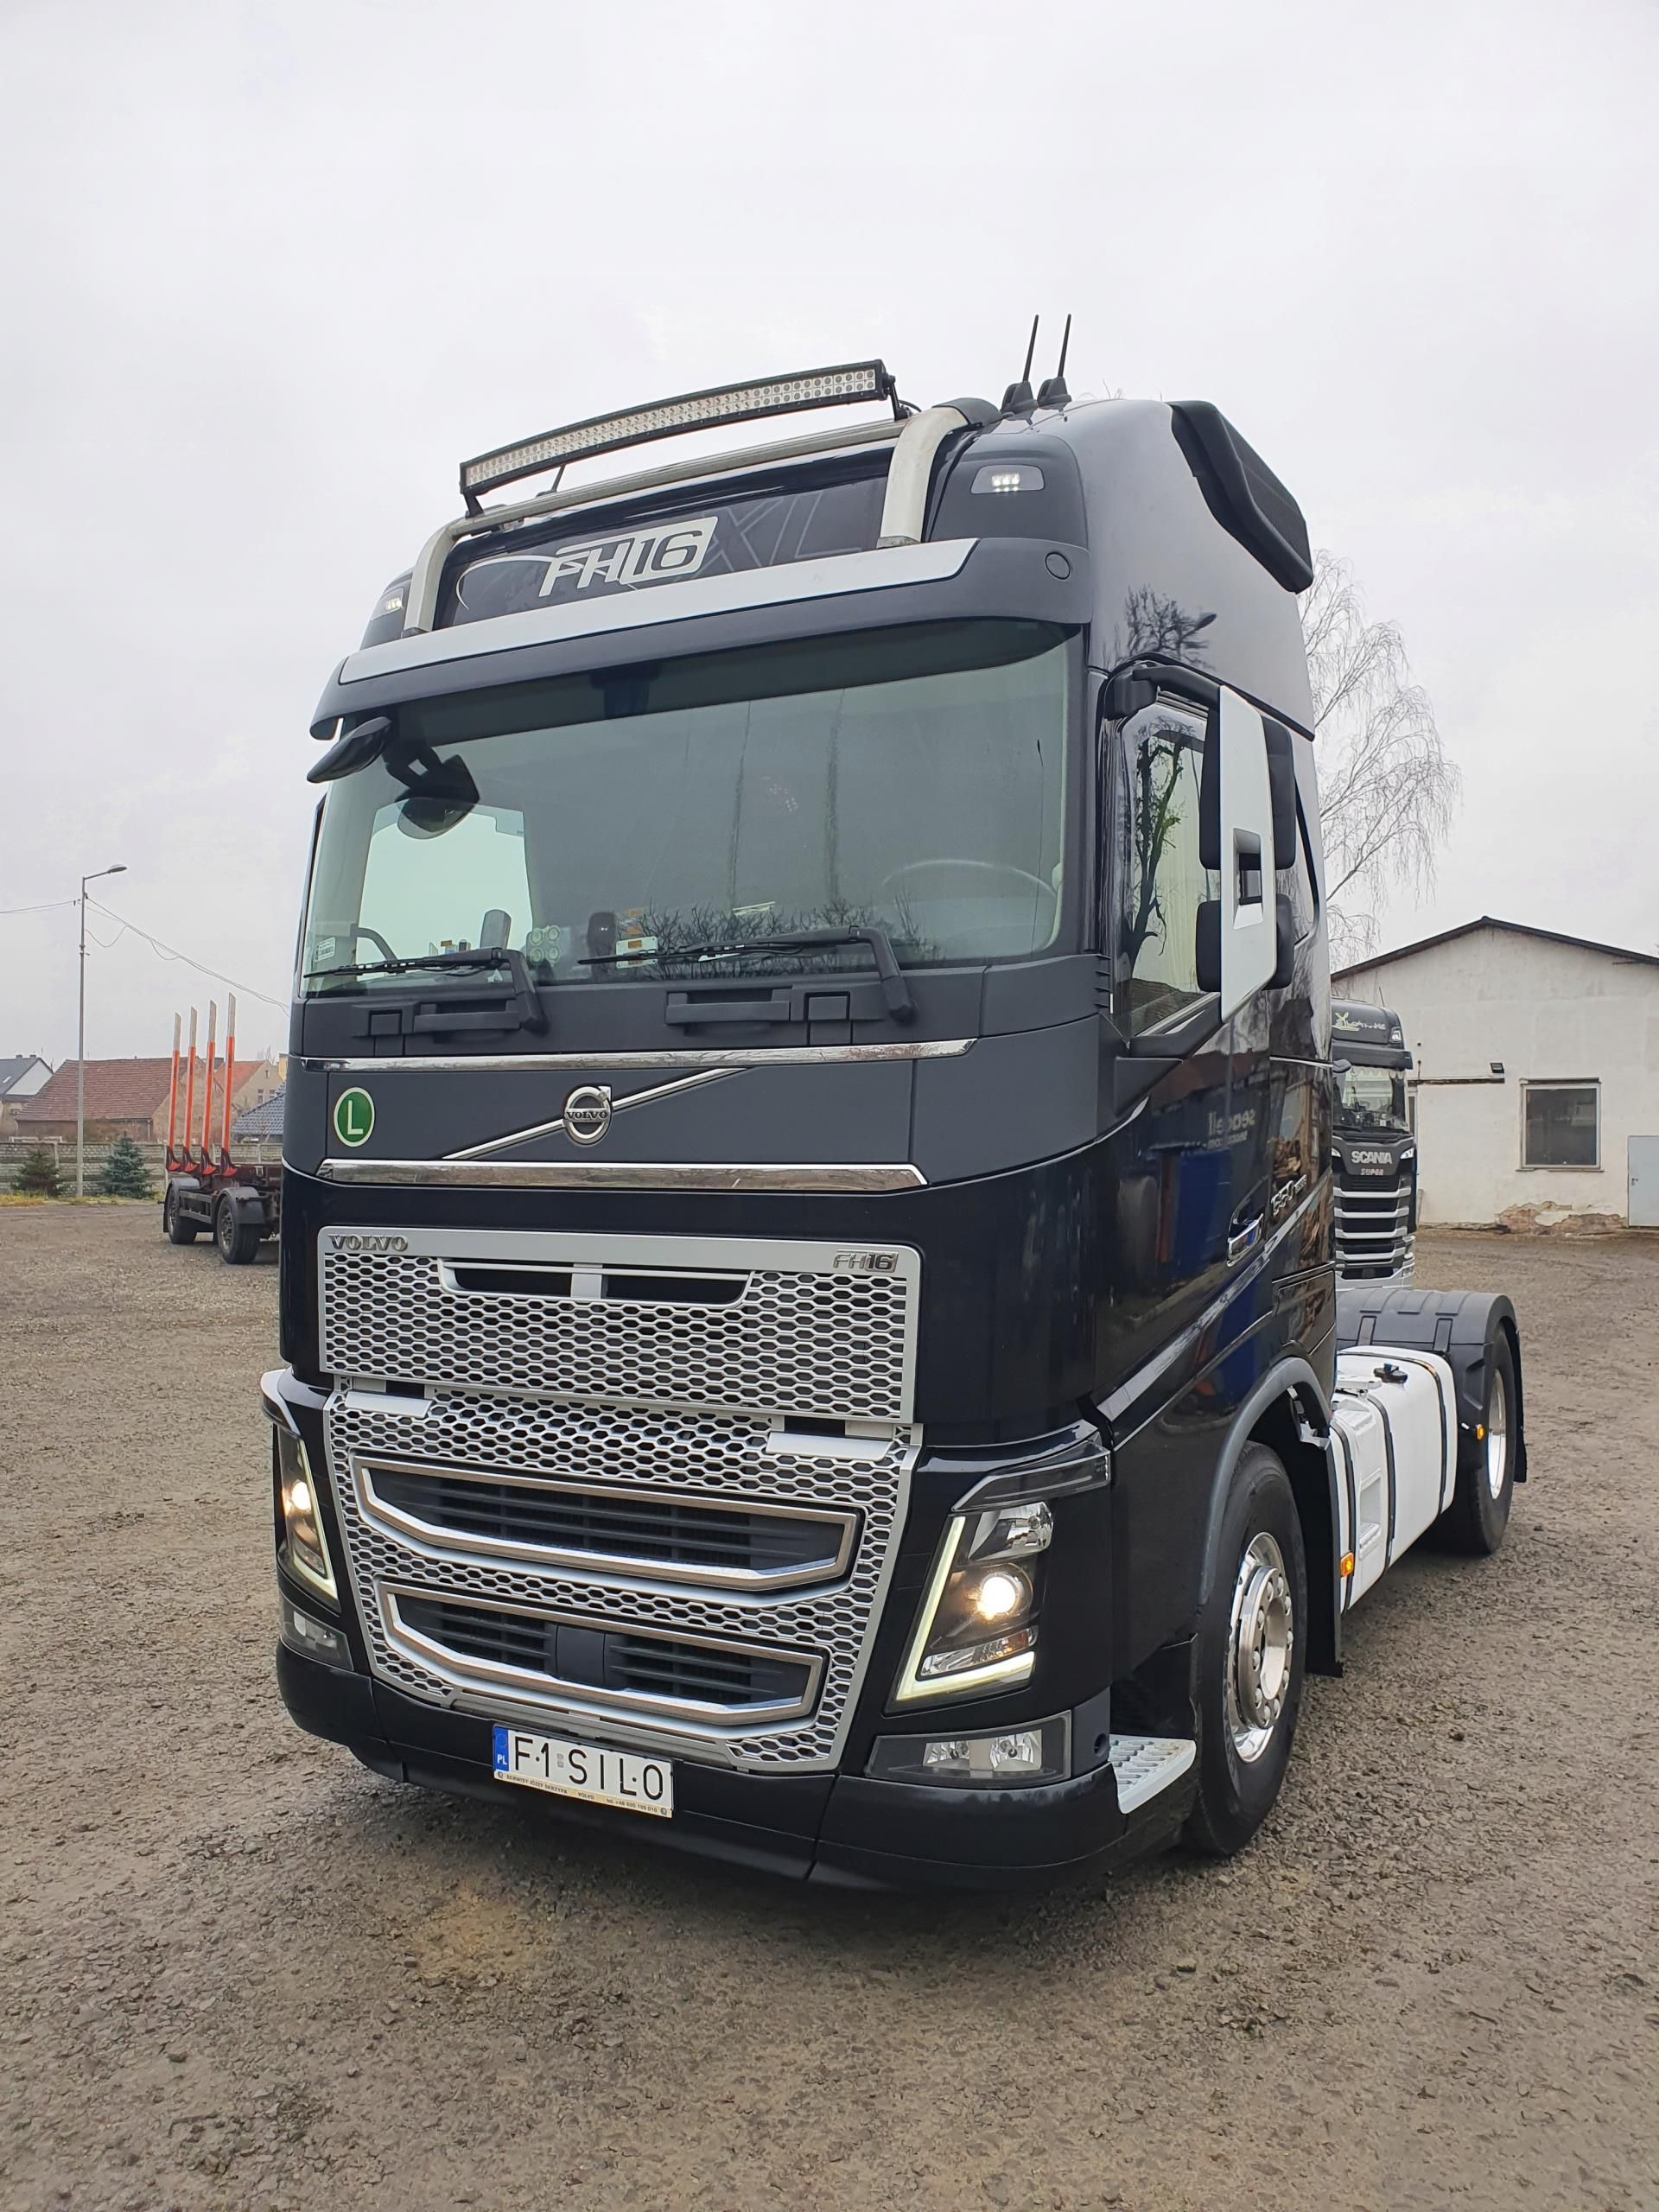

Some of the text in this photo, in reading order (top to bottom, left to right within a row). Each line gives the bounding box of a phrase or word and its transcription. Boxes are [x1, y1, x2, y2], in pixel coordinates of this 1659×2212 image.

[538, 516, 718, 597] FH16
[347, 1099, 364, 1135] L
[566, 1111, 608, 1120] VOLVO
[1351, 1150, 1393, 1165] SCANIA
[328, 1234, 409, 1252] VOLVO
[832, 1249, 899, 1273] FH16
[497, 1754, 508, 1766] PL
[568, 1748, 664, 1801] SILO
[577, 1791, 594, 1800] VOLVO
